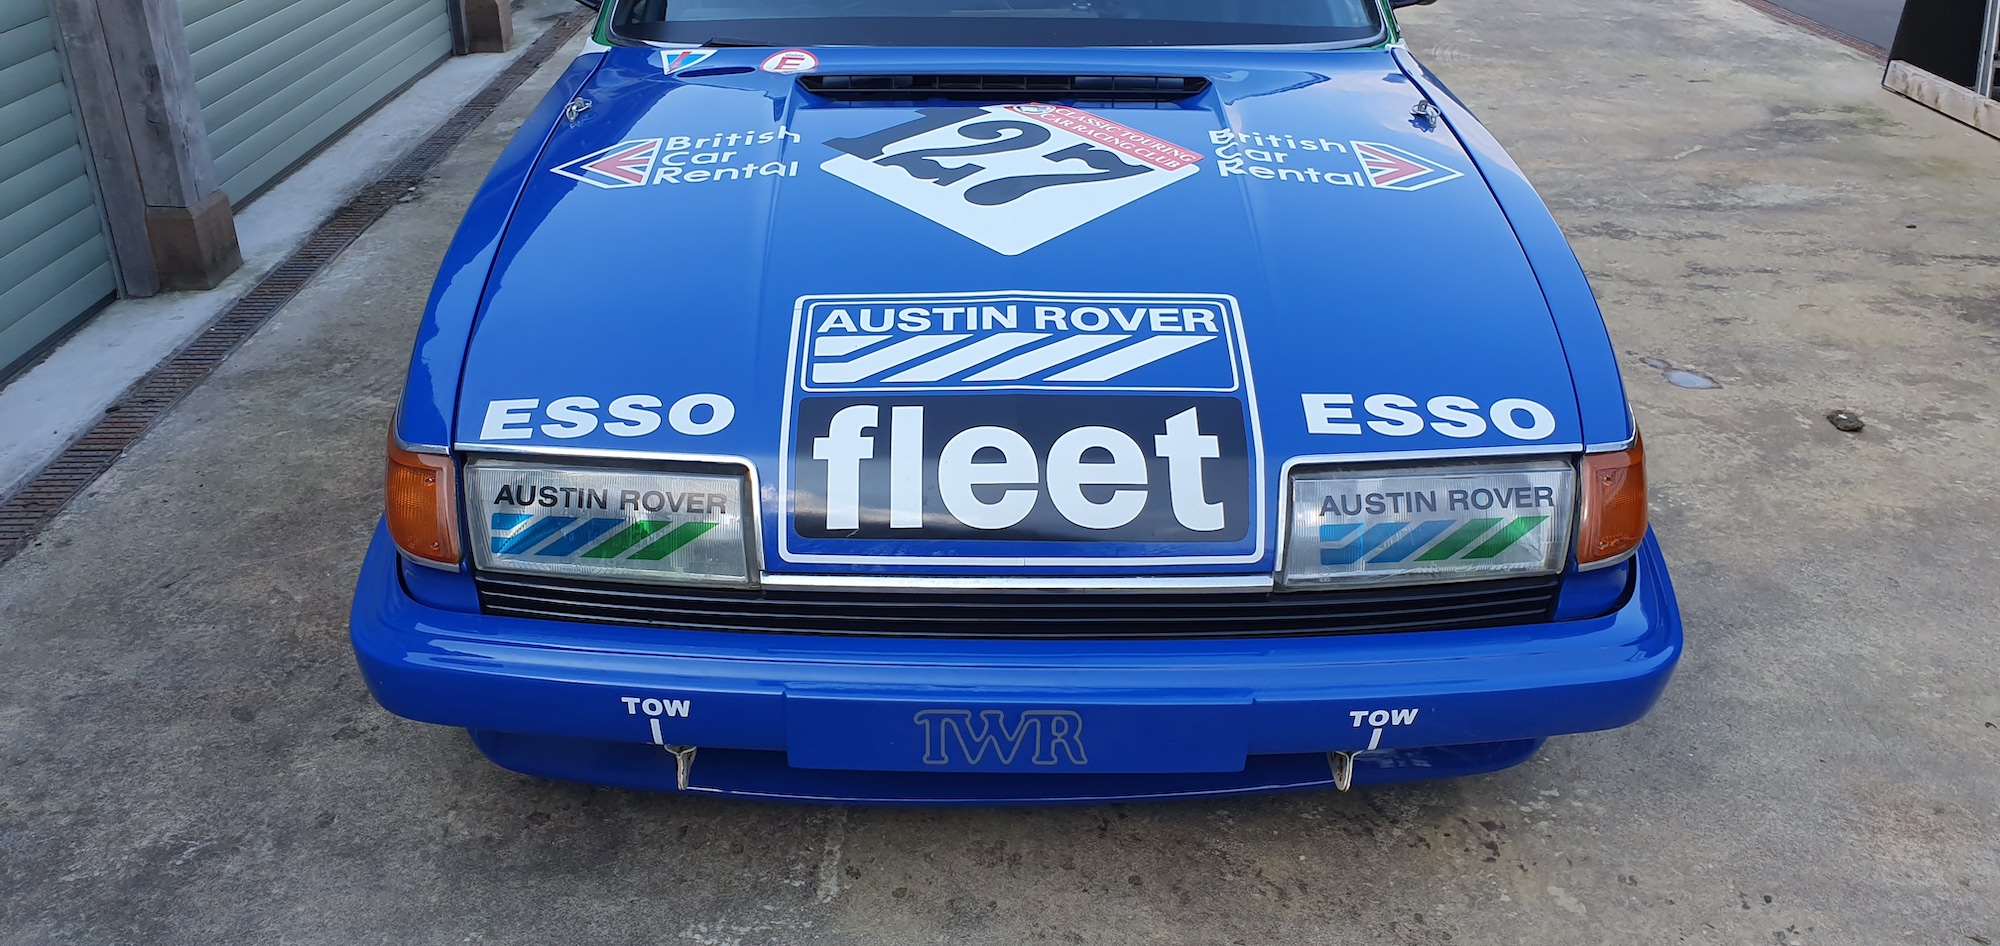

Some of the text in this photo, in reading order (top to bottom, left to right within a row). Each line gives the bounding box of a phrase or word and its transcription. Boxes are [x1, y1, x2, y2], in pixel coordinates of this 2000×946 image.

[664, 125, 801, 151] British
[1040, 112, 1181, 170] CAR RACING CLUB
[1055, 108, 1196, 162] CLASSIC TOURING
[1207, 128, 1348, 154] British
[661, 150, 738, 167] Car
[821, 107, 1155, 206] 127
[1214, 142, 1289, 164] Car
[652, 161, 799, 185] Rental
[1216, 160, 1366, 188] Rental
[817, 305, 1219, 333] AUSTIN ROVER
[479, 393, 736, 441] ESSO
[1300, 393, 1556, 441] ESSO
[812, 405, 1226, 532] fleet
[494, 484, 726, 515] AUSTIN ROVER
[1319, 486, 1555, 517] AUSTIN ROVER
[621, 697, 691, 718] TOW
[1349, 708, 1419, 728] TOW
[914, 709, 1089, 766] TWR
